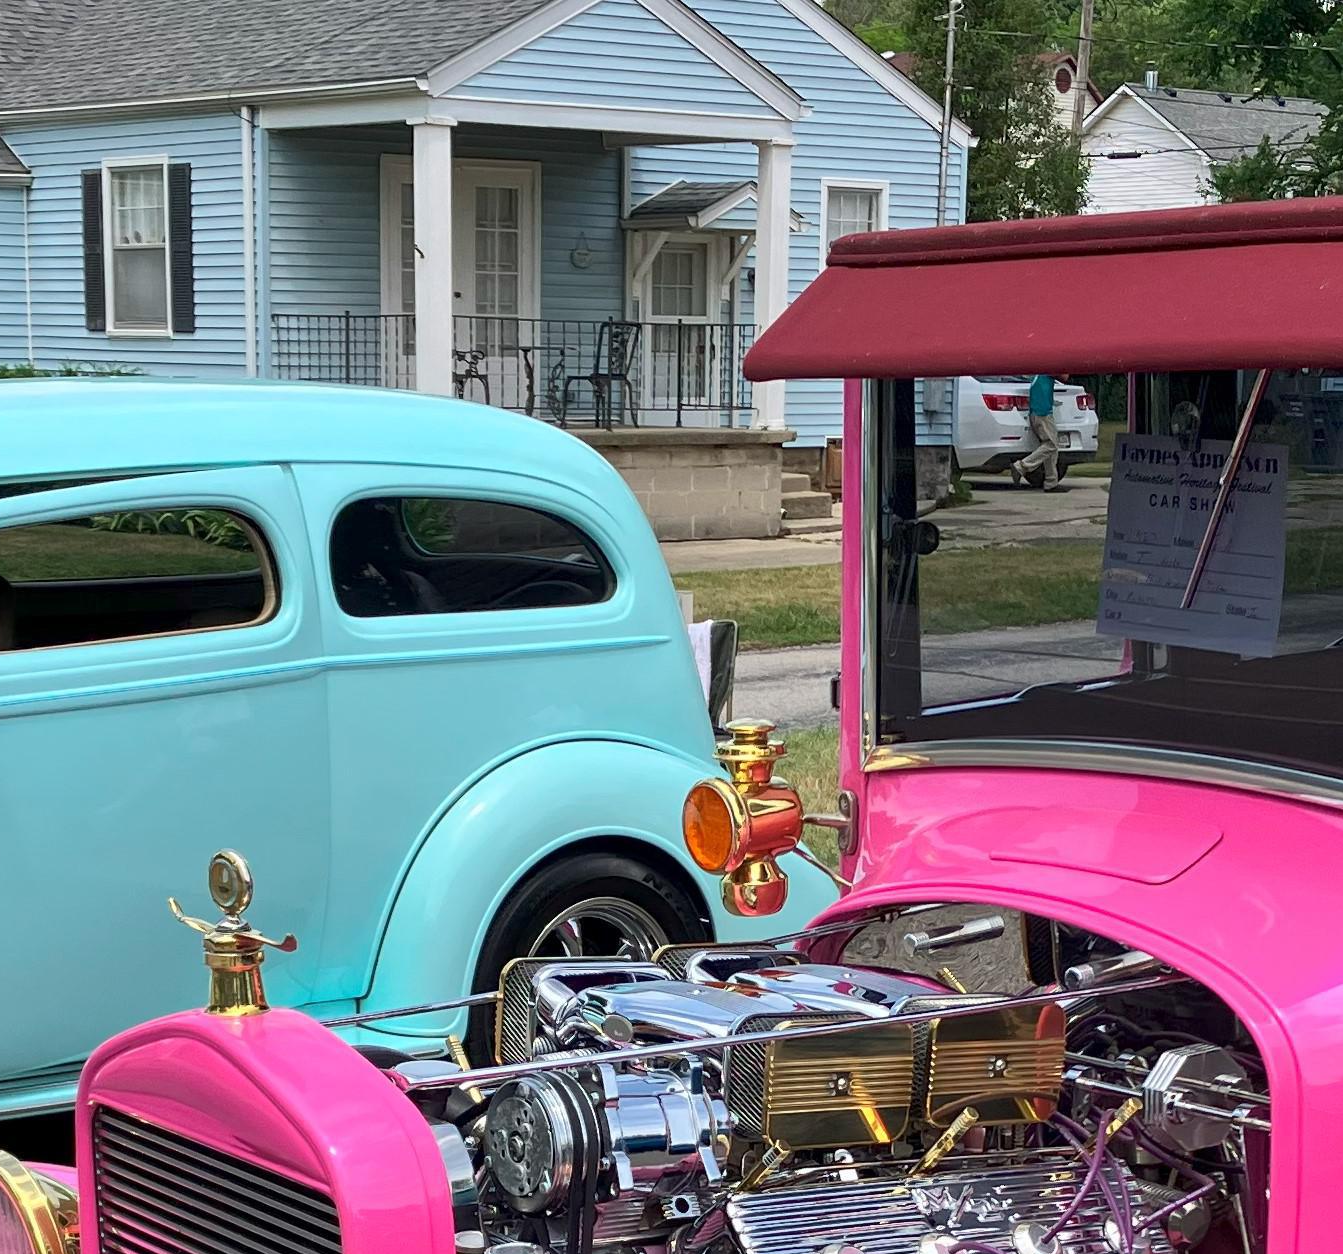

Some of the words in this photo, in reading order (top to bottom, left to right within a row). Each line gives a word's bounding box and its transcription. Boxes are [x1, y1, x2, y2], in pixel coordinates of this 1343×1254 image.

[1189, 450, 1279, 475] Appson
[1179, 472, 1223, 493] Heritag
[1149, 493, 1181, 509] CAR
[1189, 497, 1236, 514] SHW
